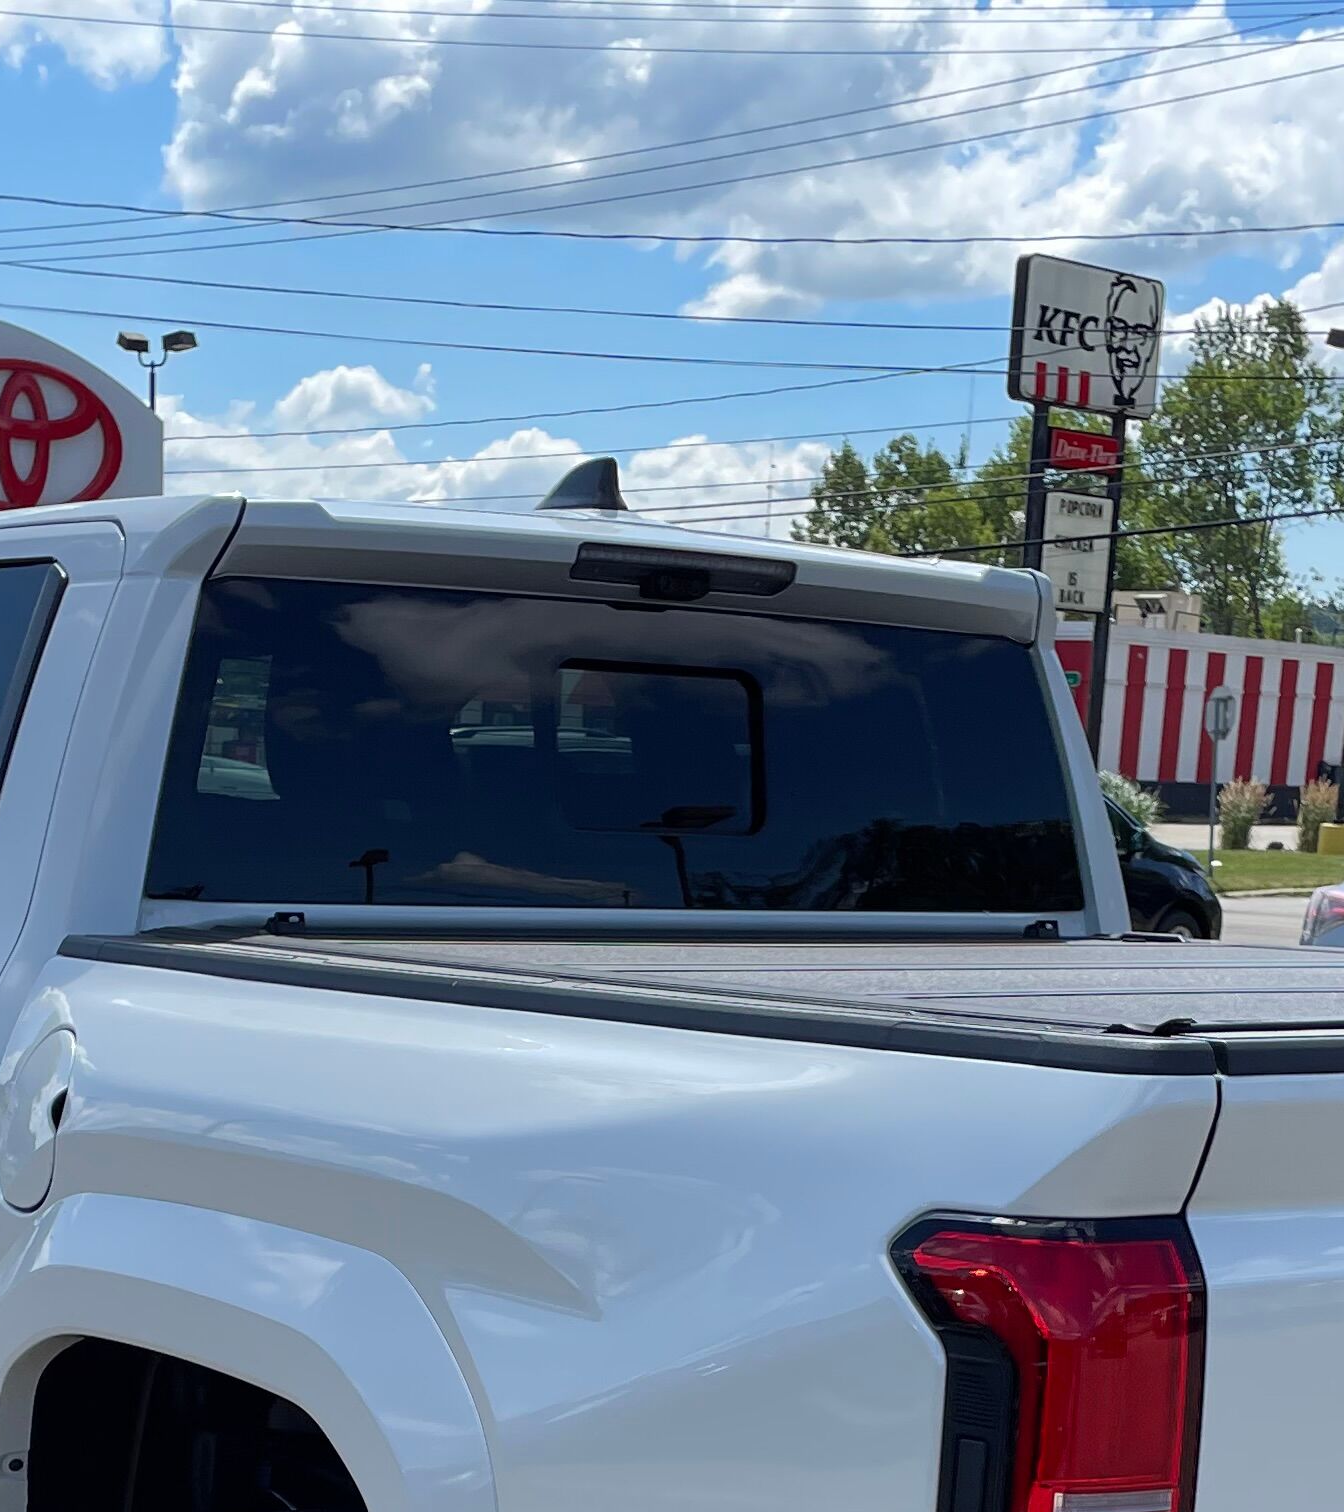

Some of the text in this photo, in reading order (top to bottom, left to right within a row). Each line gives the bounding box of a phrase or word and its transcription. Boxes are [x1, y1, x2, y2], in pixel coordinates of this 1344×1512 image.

[1032, 304, 1100, 352] KFC
[1059, 498, 1103, 518] POPCORN
[1058, 589, 1085, 604] BACK
